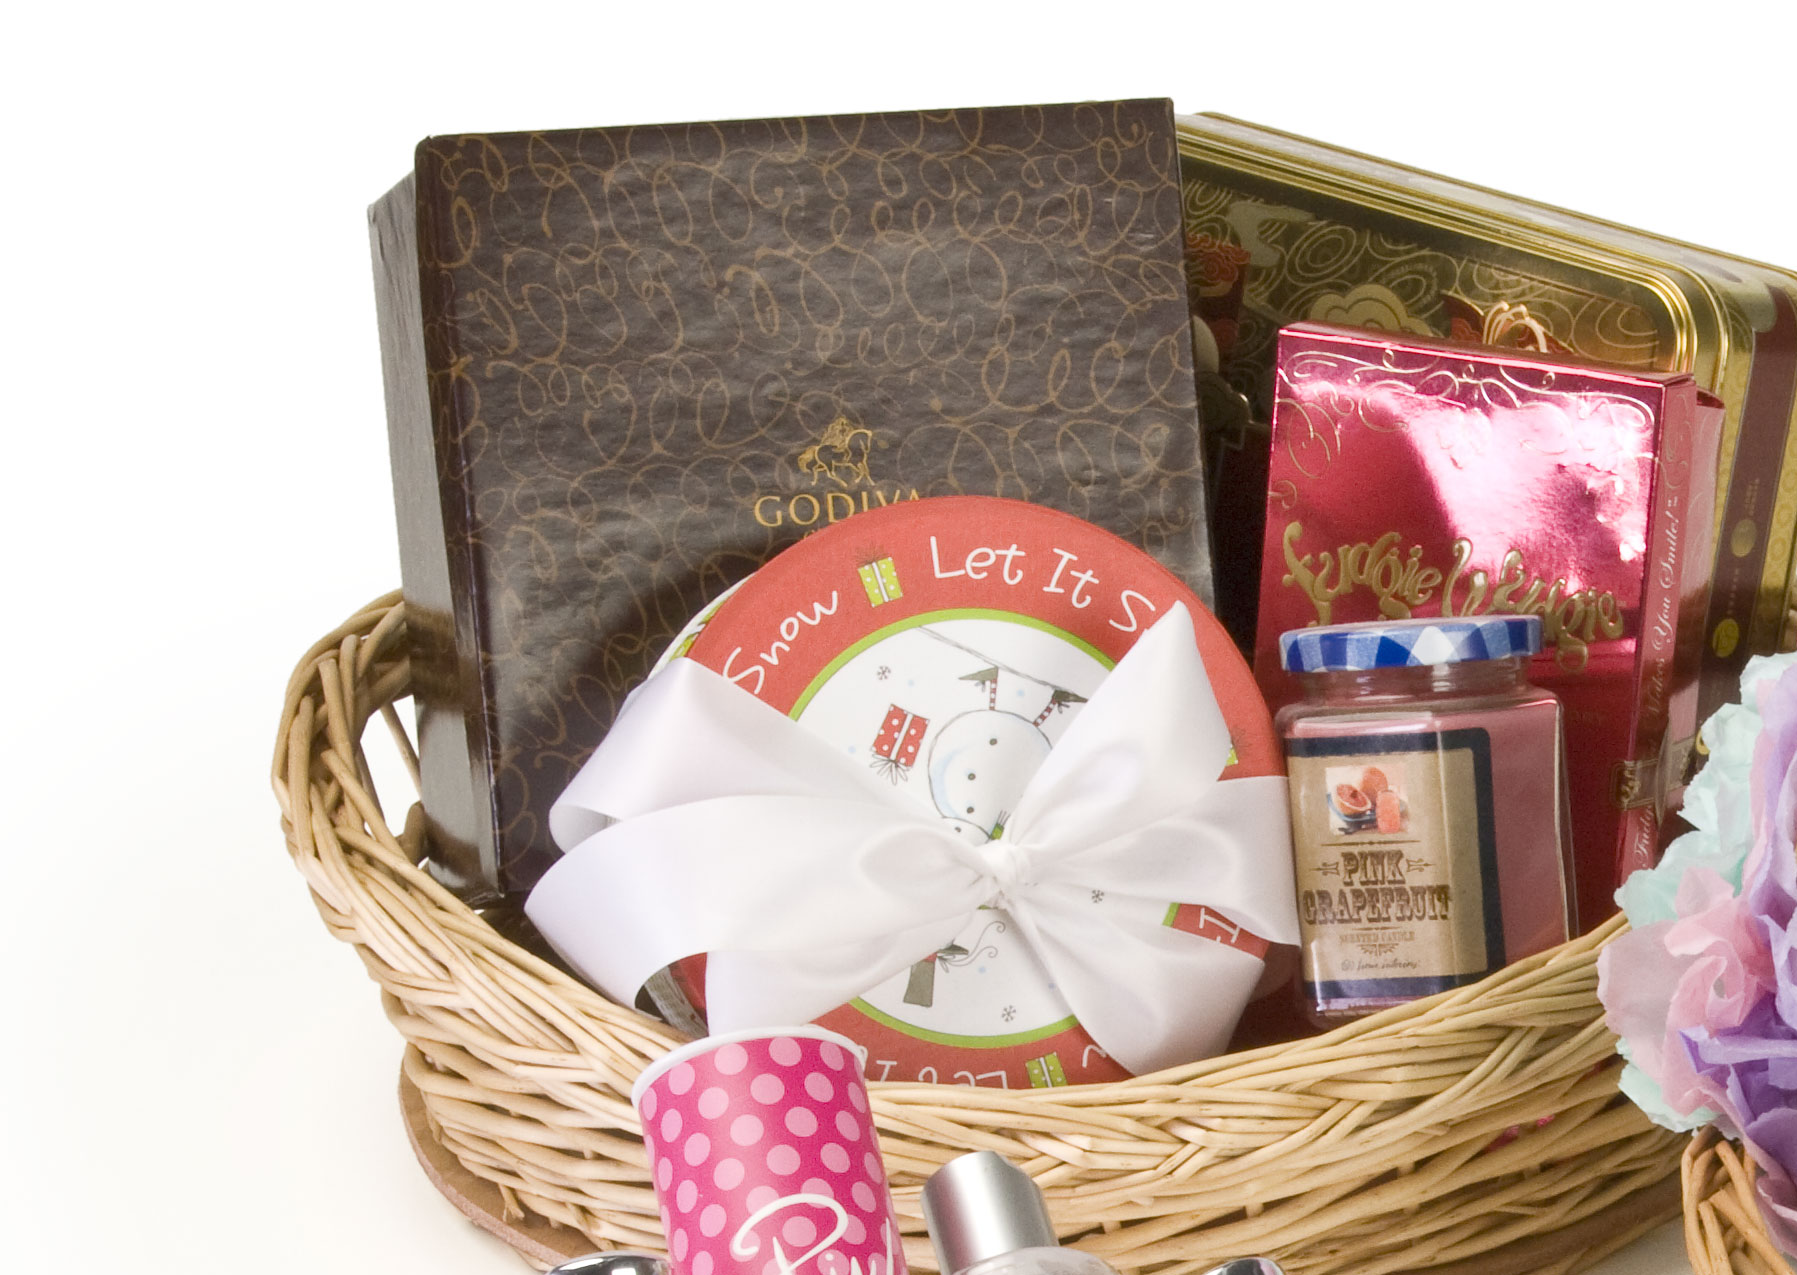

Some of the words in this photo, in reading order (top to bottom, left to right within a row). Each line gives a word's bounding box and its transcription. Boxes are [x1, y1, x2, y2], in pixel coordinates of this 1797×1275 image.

[930, 535, 1026, 586] Let
[1041, 547, 1100, 609] It
[722, 590, 839, 695] Snow
[1651, 596, 1674, 651] You
[1340, 849, 1406, 887] PINK
[1301, 883, 1454, 926] GRAPEFRUIT
